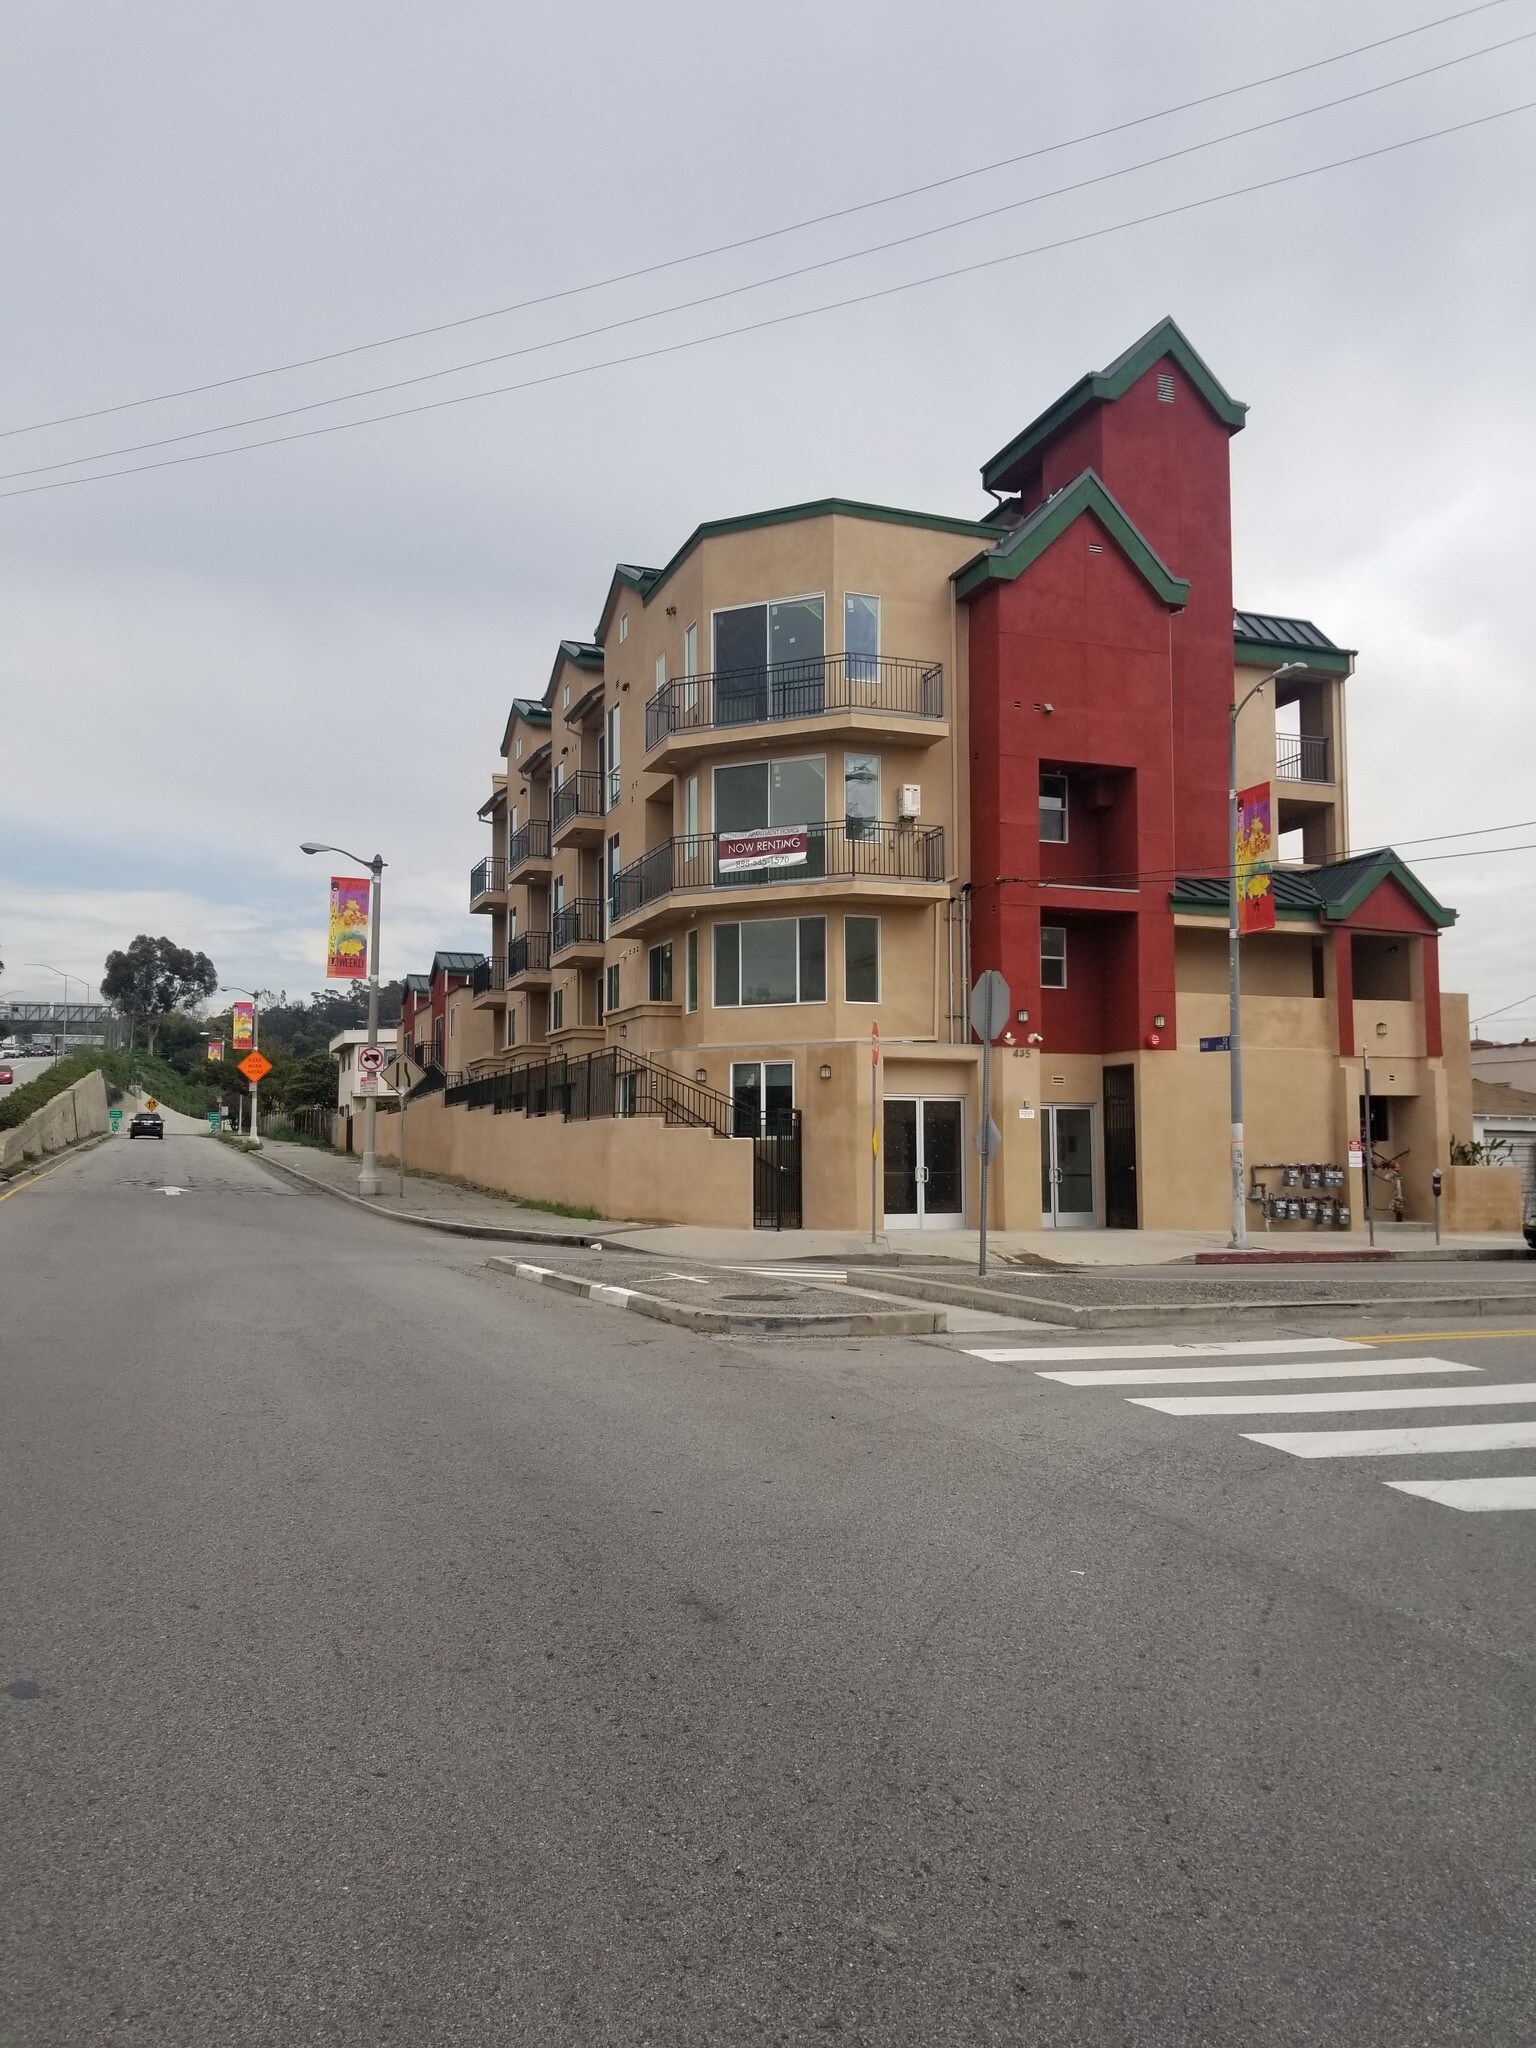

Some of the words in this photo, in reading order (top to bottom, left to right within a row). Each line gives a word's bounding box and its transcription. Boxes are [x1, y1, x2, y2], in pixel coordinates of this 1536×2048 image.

[728, 842, 755, 854] NOW
[757, 838, 801, 851] RENTING
[340, 957, 365, 968] WEEKLY
[1222, 1037, 1228, 1045] St
[1013, 1049, 1031, 1058] 435
